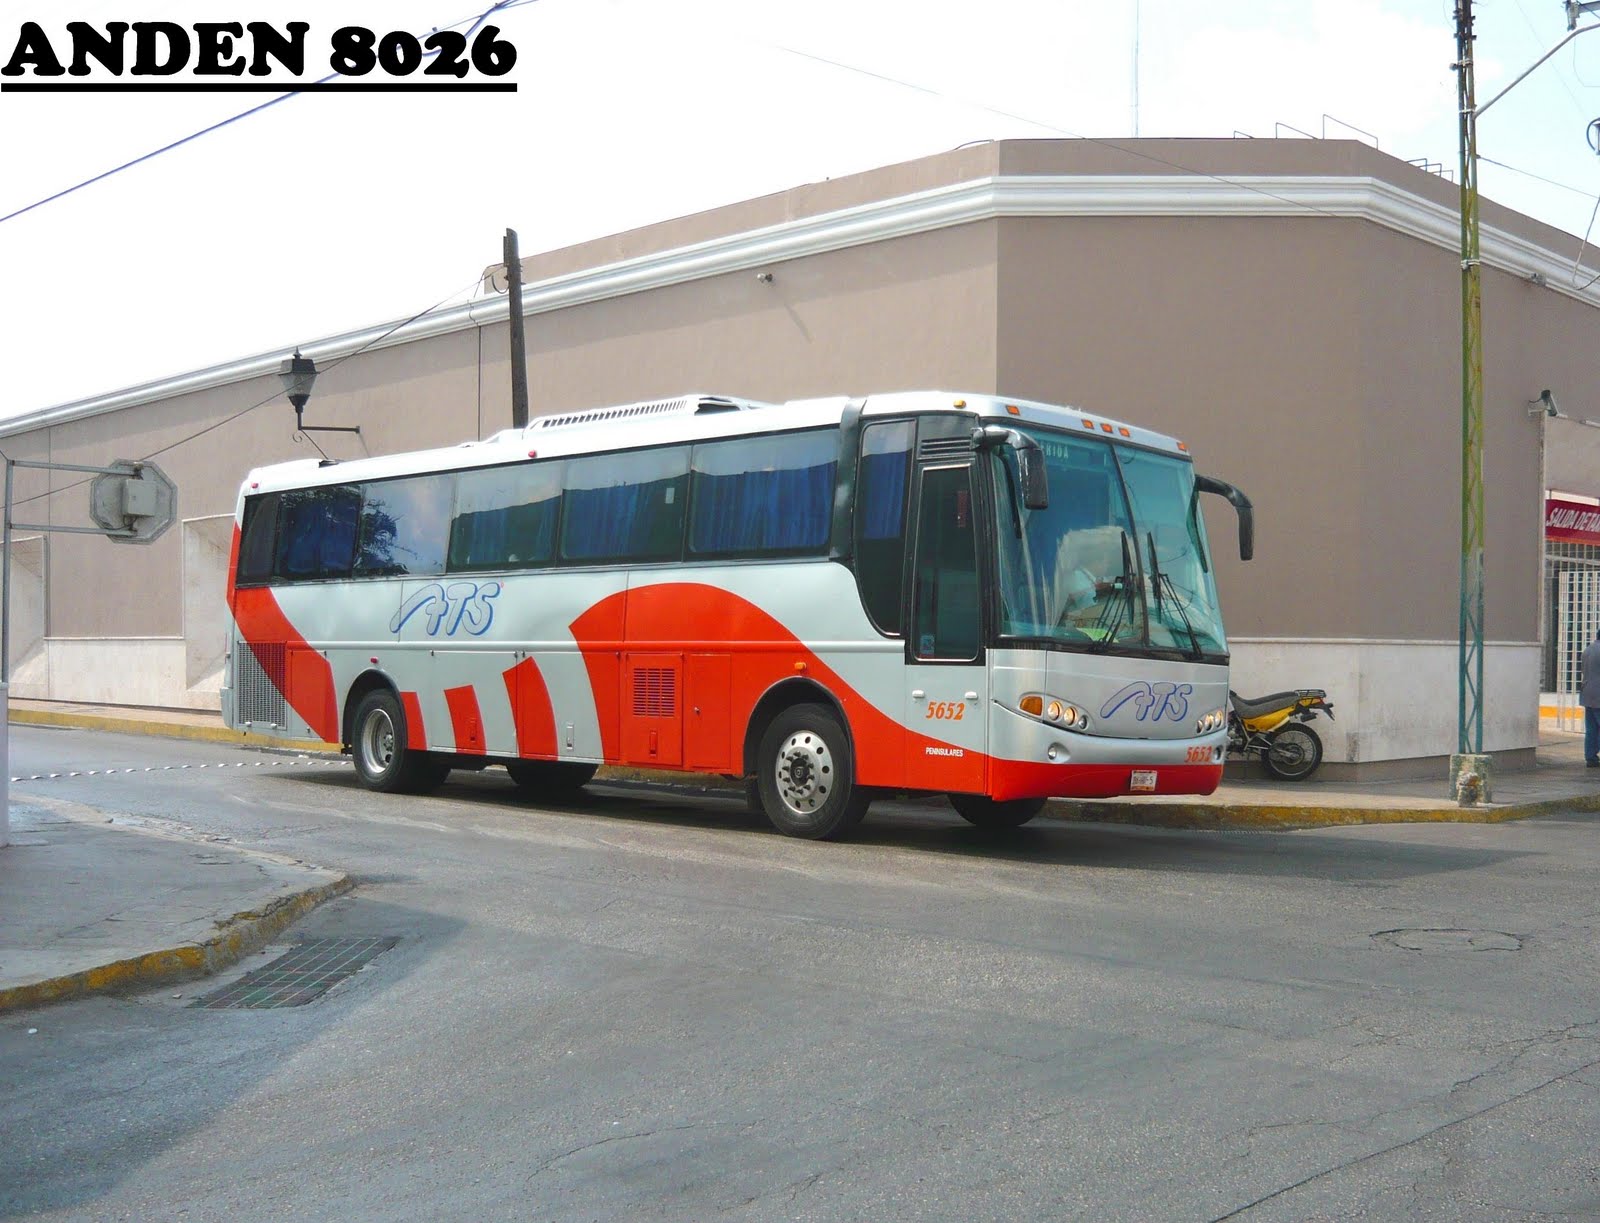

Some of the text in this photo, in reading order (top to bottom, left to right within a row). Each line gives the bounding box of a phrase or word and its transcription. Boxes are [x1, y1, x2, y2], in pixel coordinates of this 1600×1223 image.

[1546, 507, 1579, 529] SALIDA
[1573, 511, 1592, 531] DE
[389, 582, 500, 636] ATS
[925, 701, 965, 721] 5652
[1100, 681, 1193, 722] ATS
[925, 747, 964, 758] PENINSULARES
[1184, 745, 1212, 763] 5652
